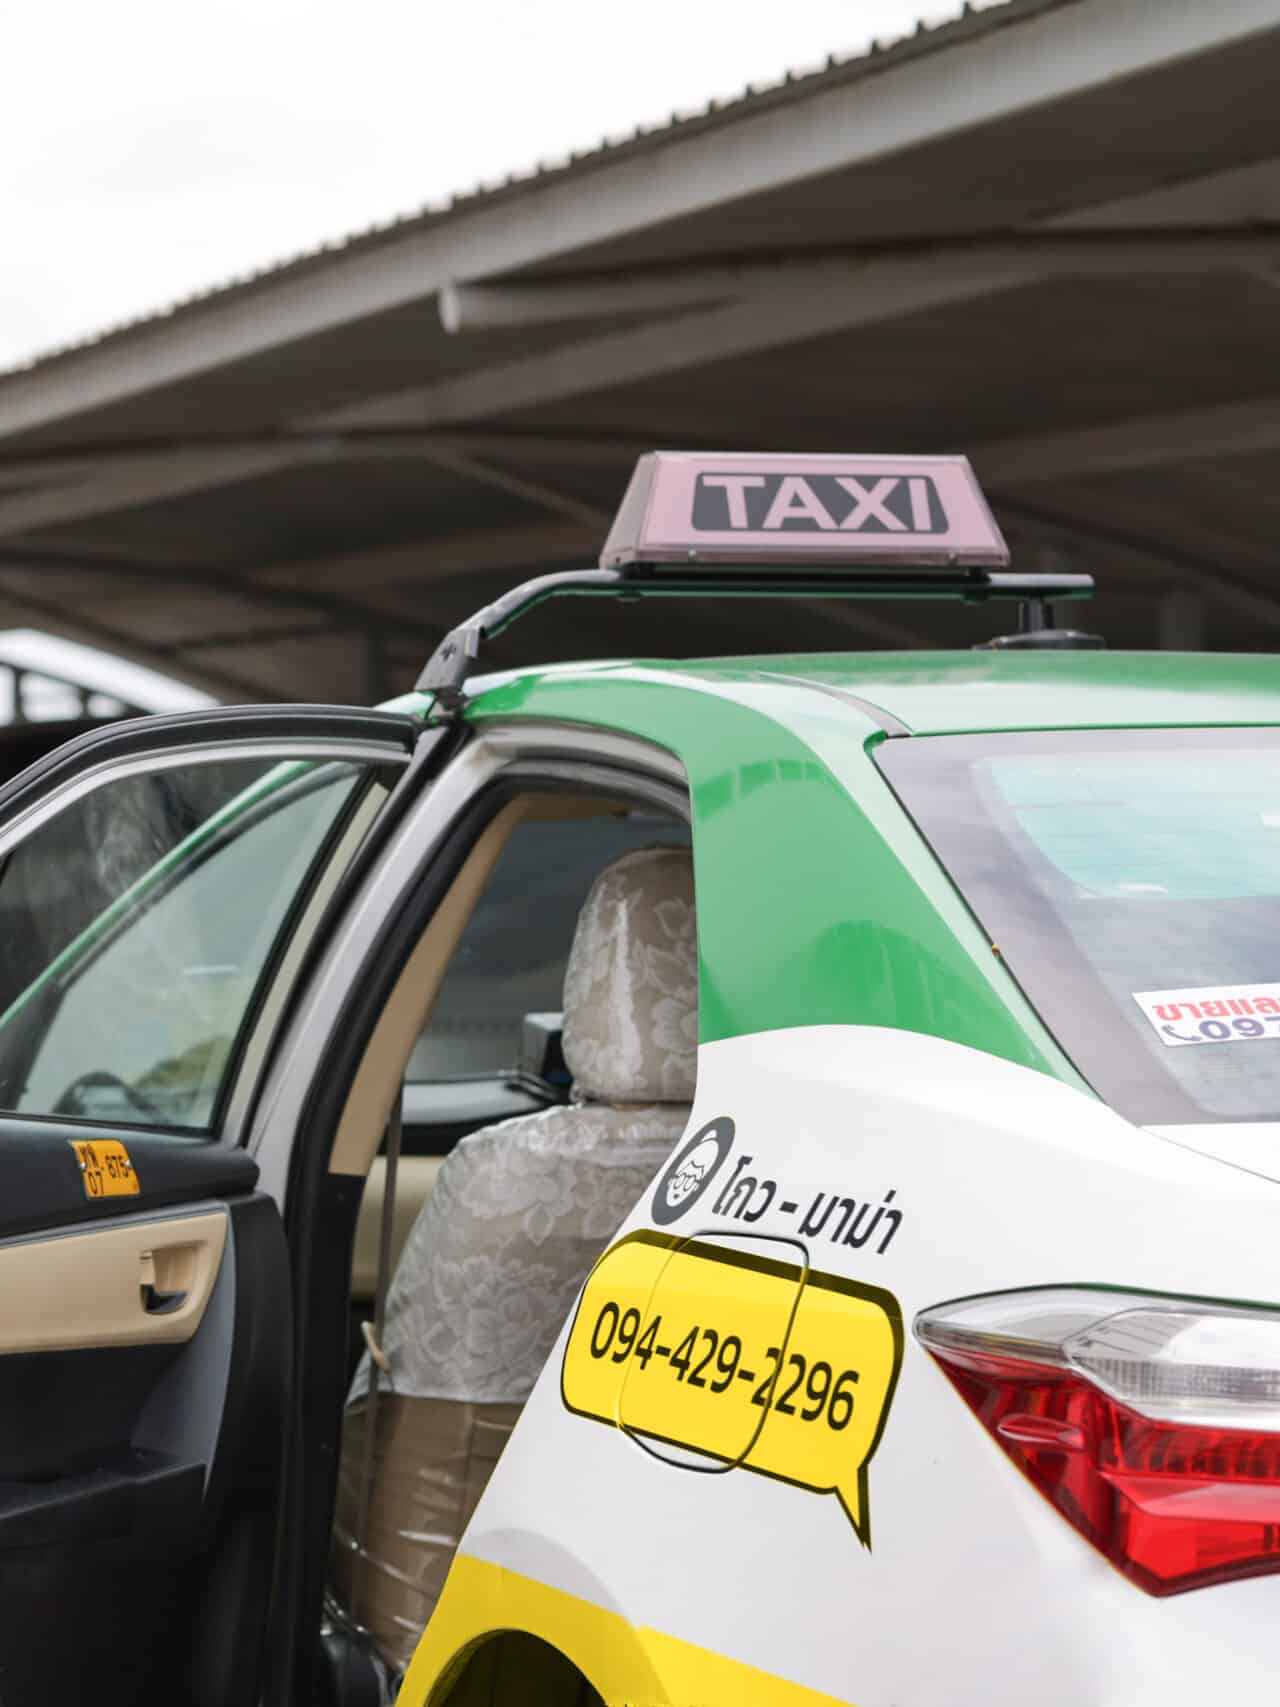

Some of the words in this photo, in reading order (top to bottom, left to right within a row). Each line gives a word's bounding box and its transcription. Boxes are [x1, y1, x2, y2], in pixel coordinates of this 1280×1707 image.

[702, 476, 931, 531] TAXI
[711, 1155, 777, 1222] โกว
[797, 1189, 903, 1254] มาม่า
[590, 1302, 860, 1431] 094-429-2296
